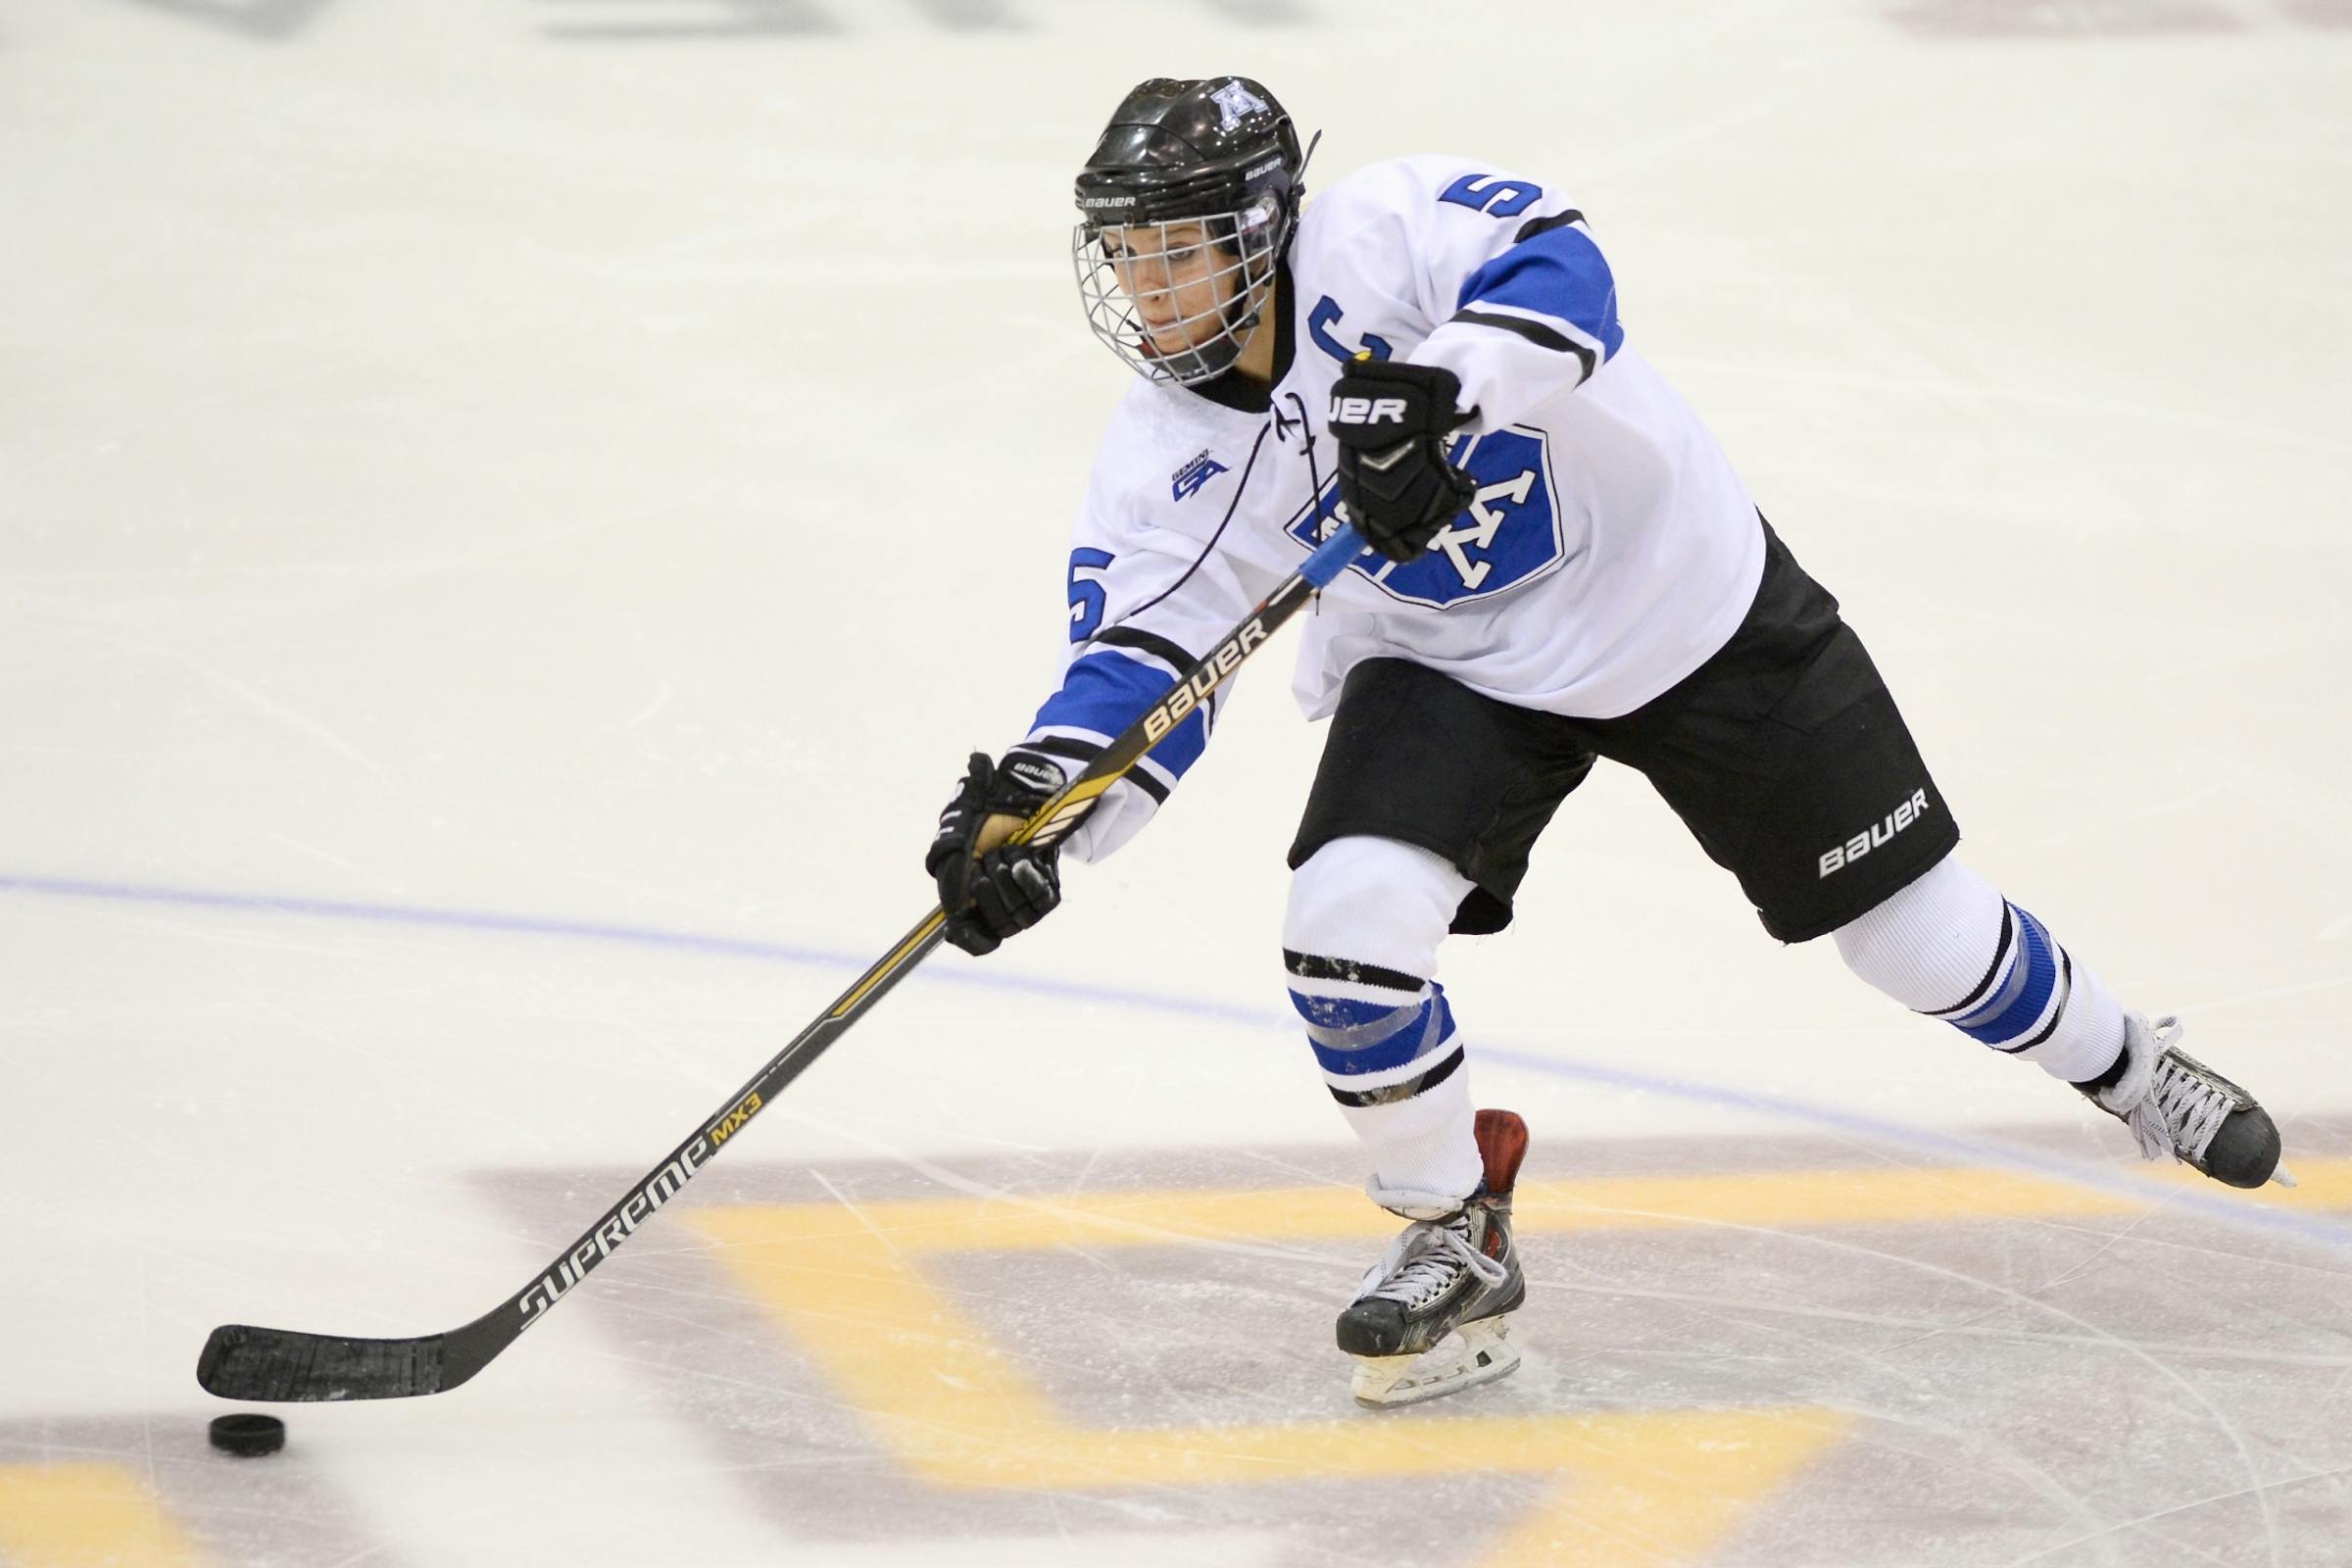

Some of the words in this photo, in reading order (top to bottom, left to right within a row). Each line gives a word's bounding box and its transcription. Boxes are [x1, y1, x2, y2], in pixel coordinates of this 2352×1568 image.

[1437, 173, 1543, 219] 5
[1307, 294, 1394, 364] C
[1067, 547, 1116, 645] 5
[710, 1092, 763, 1147] MX3
